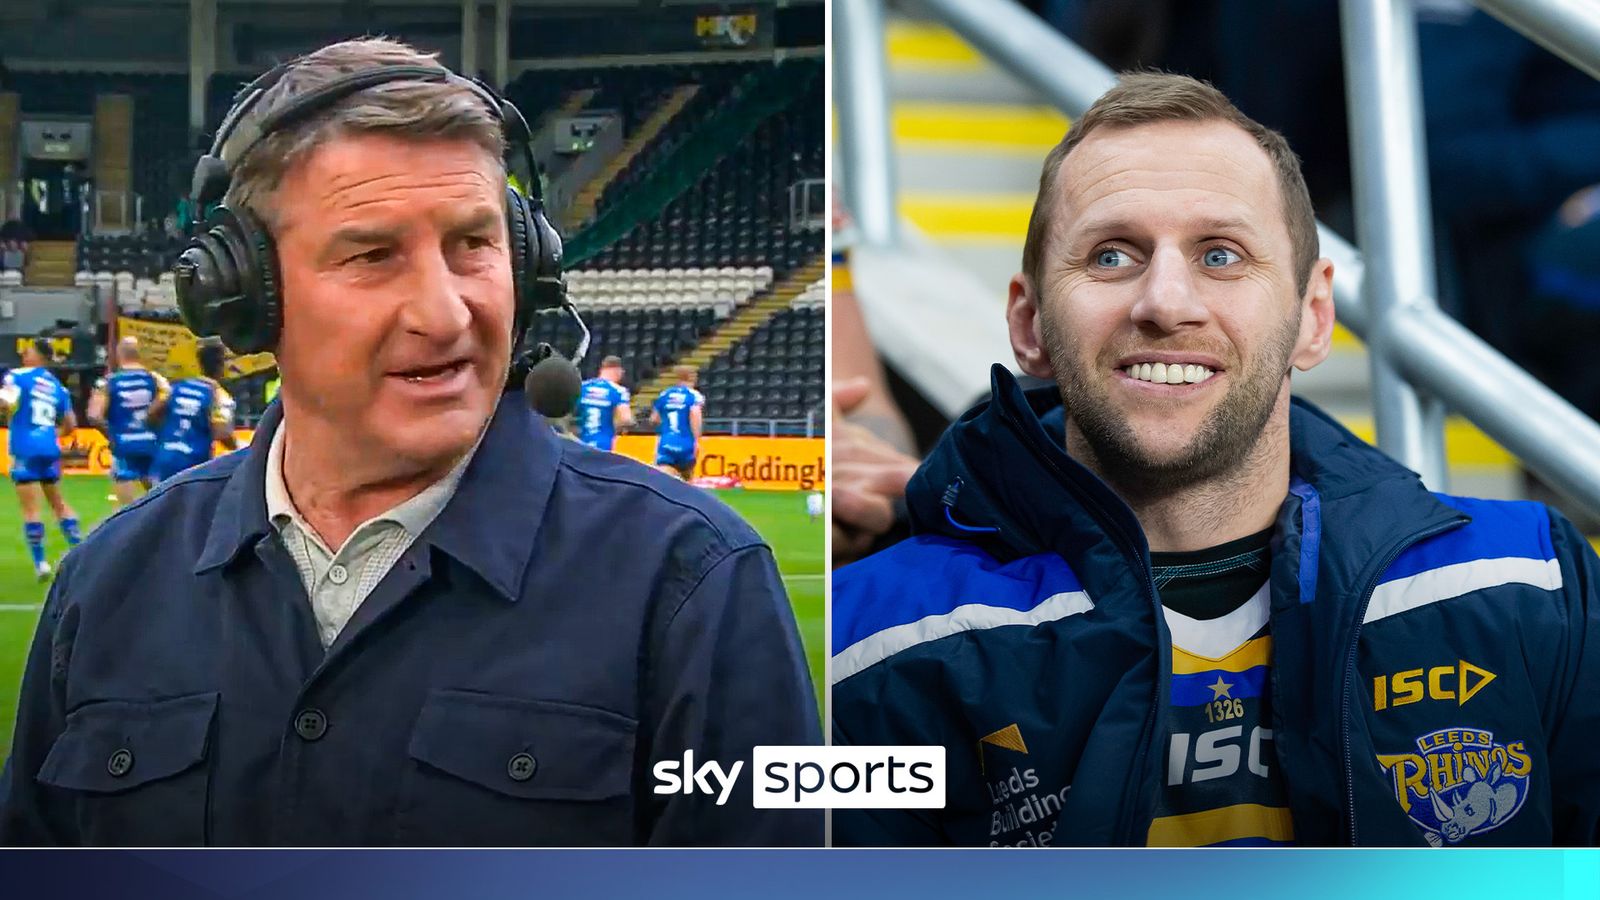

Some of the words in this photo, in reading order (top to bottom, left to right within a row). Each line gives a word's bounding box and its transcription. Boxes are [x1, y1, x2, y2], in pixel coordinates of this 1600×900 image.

[1373, 665, 1456, 711] ISC
[1205, 698, 1245, 723] 1326
[1419, 731, 1492, 751] LEEDS
[986, 766, 1040, 805] Leds
